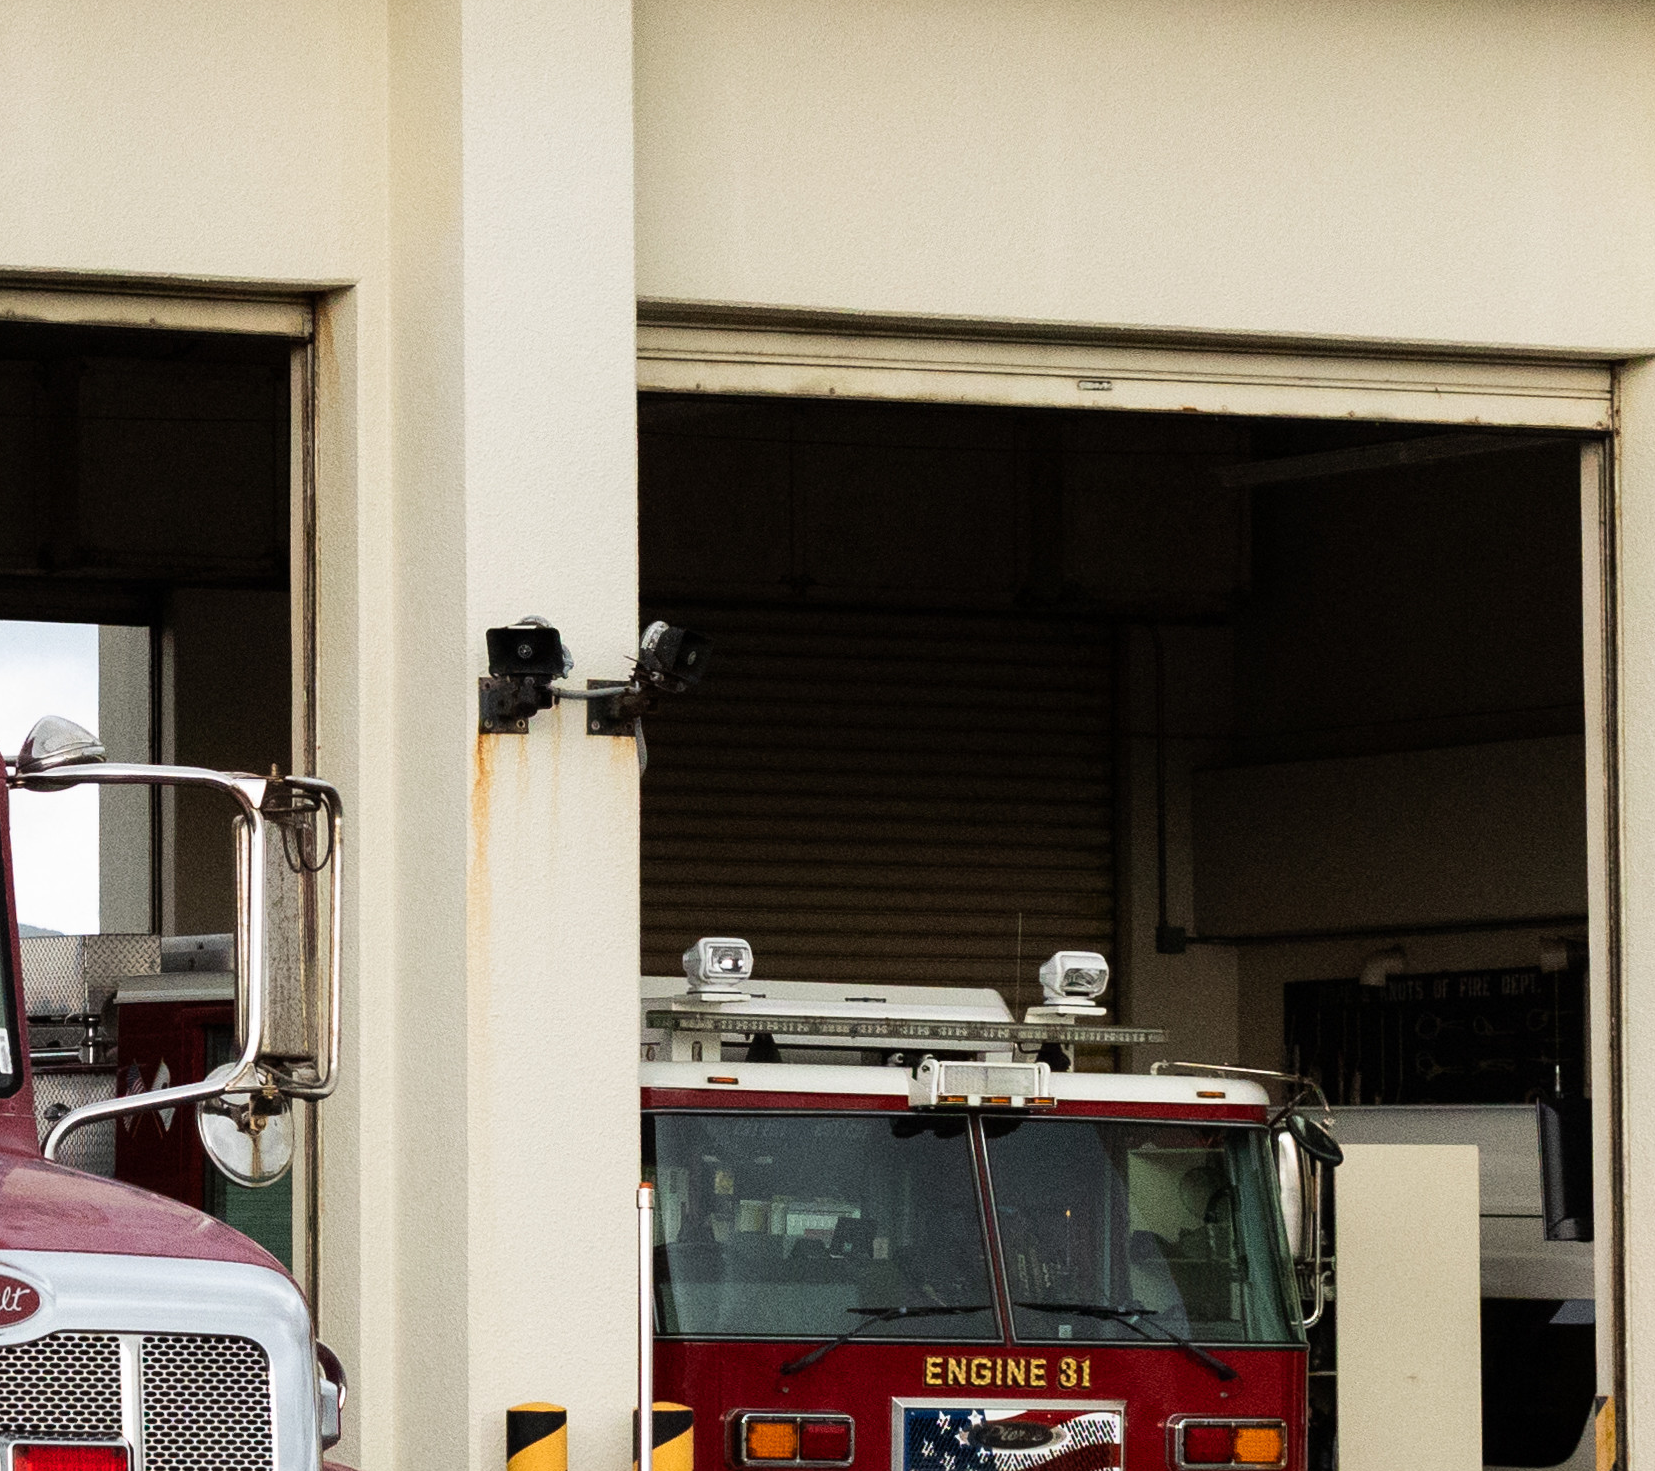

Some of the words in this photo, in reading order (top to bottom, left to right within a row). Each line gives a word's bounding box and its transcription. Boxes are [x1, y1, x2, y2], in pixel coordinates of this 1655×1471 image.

[1460, 976, 1491, 998] FIRE
[1501, 973, 1543, 995] DEPT.
[924, 1356, 1048, 1388] ENGINE
[1058, 1356, 1091, 1389] 31
